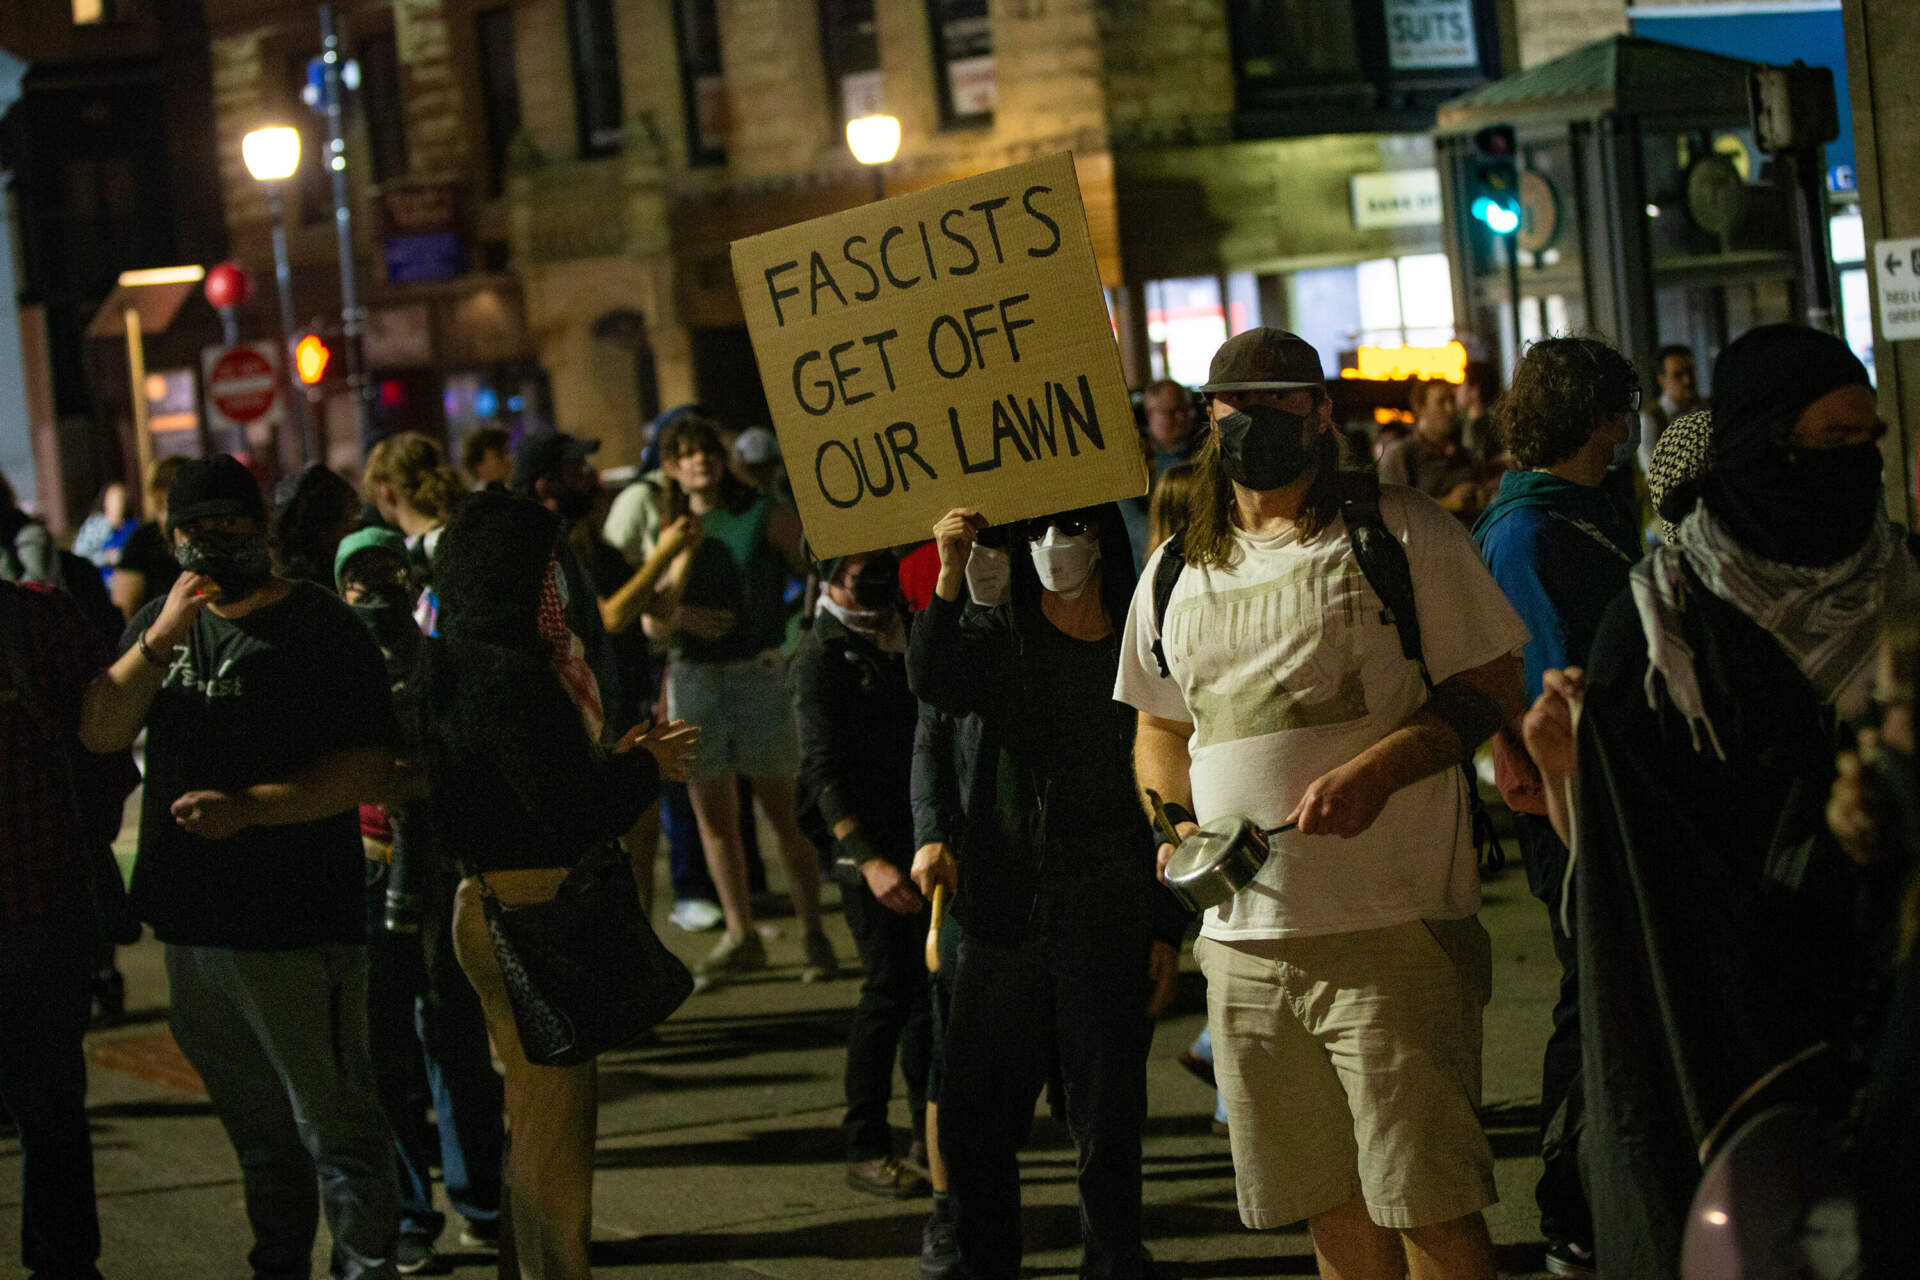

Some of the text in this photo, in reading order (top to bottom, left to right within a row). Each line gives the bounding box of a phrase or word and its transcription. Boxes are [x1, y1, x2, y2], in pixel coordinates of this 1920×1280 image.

[1392, 12, 1465, 43] SUITS
[764, 186, 1061, 328] FASCISTS
[792, 294, 1034, 416] GET OFF
[815, 374, 1105, 509] OUR LAWN
